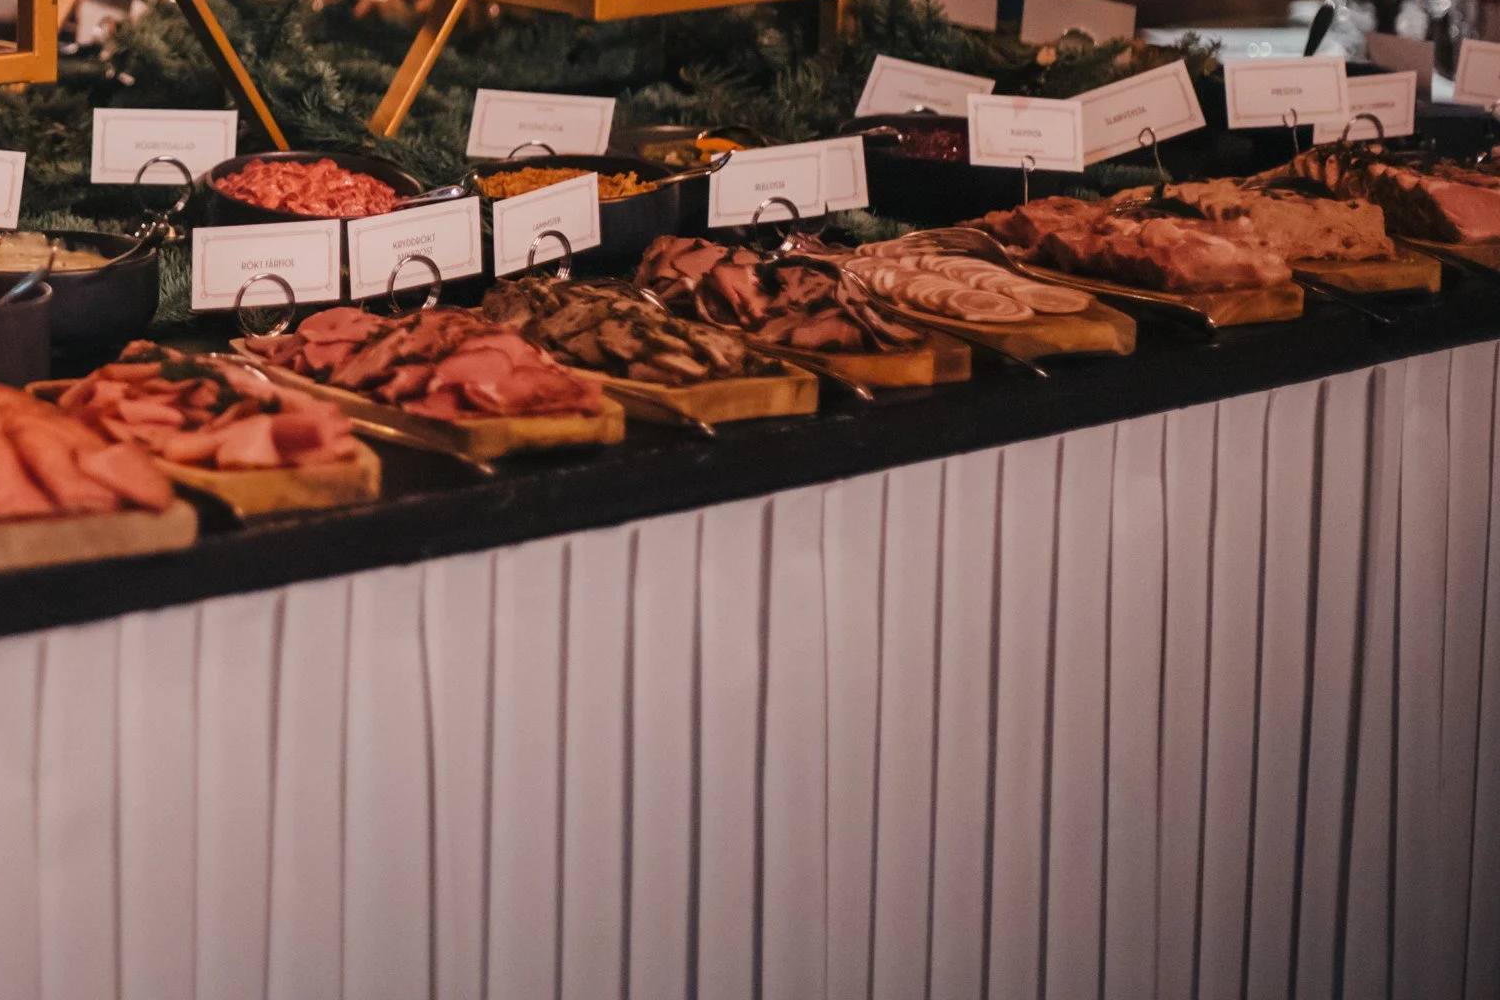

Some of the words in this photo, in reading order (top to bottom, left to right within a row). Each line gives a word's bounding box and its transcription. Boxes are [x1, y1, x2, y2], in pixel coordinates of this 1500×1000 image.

[392, 232, 436, 250] KRYDDRÖKT
[241, 258, 263, 270] RÖKT
[265, 257, 295, 268] FÅRFIOL
